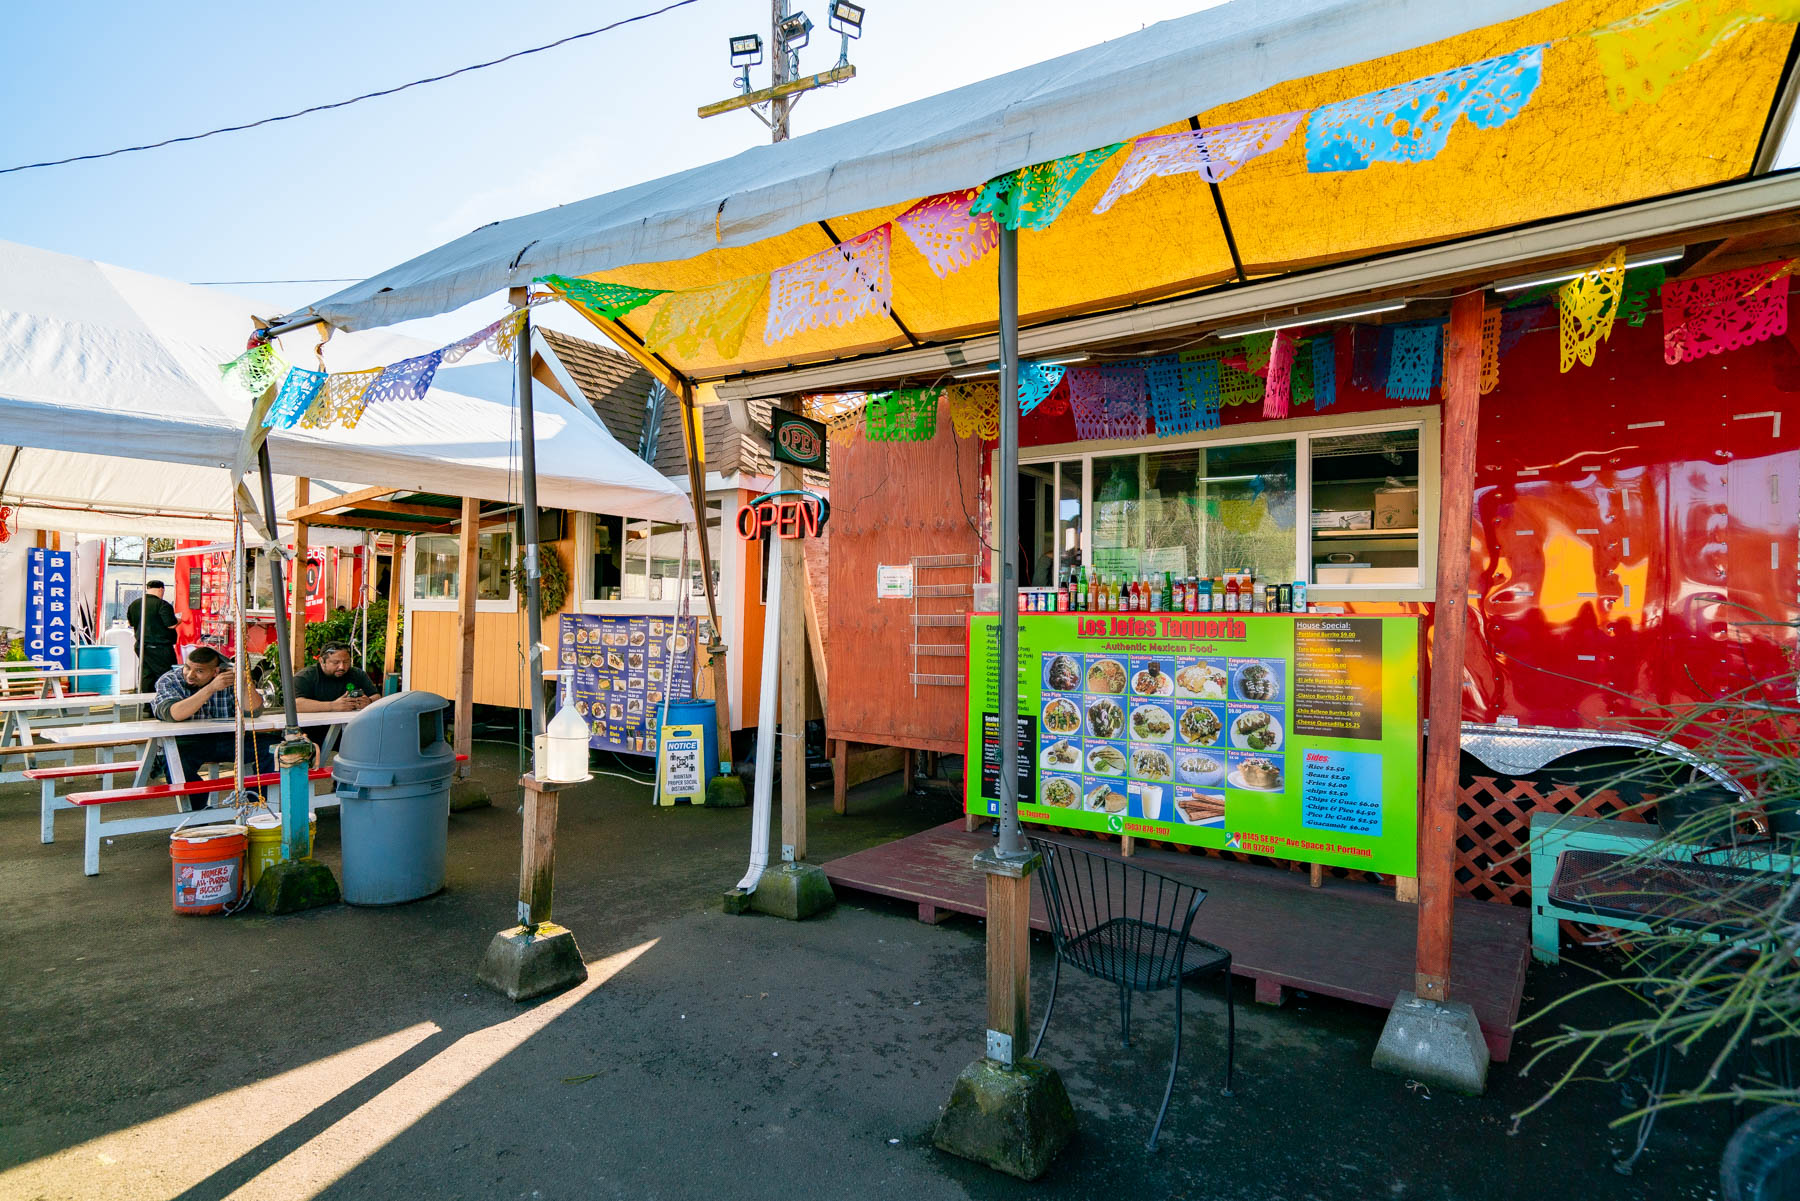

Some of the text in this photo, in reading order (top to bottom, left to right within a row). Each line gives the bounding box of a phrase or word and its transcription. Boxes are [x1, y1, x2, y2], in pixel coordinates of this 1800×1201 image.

[779, 427, 820, 456] OPEN
[736, 500, 819, 540] OPEN
[50, 558, 64, 670] BARBACOA
[1078, 616, 1246, 639] Los Jefes Taqueria
[1322, 622, 1351, 630] Special:
[1150, 643, 1188, 653] Mexican
[668, 742, 697, 750] NOTICE
[1306, 753, 1330, 762] Sides:
[1026, 810, 1050, 820] Taqueria
[1306, 819, 1347, 829] -Guacamole
[1242, 842, 1275, 854] OR 97266
[1286, 838, 1300, 846] Ave
[1301, 840, 1324, 851] Space
[1337, 845, 1373, 858] Portland,
[200, 885, 224, 895] BUCKET
